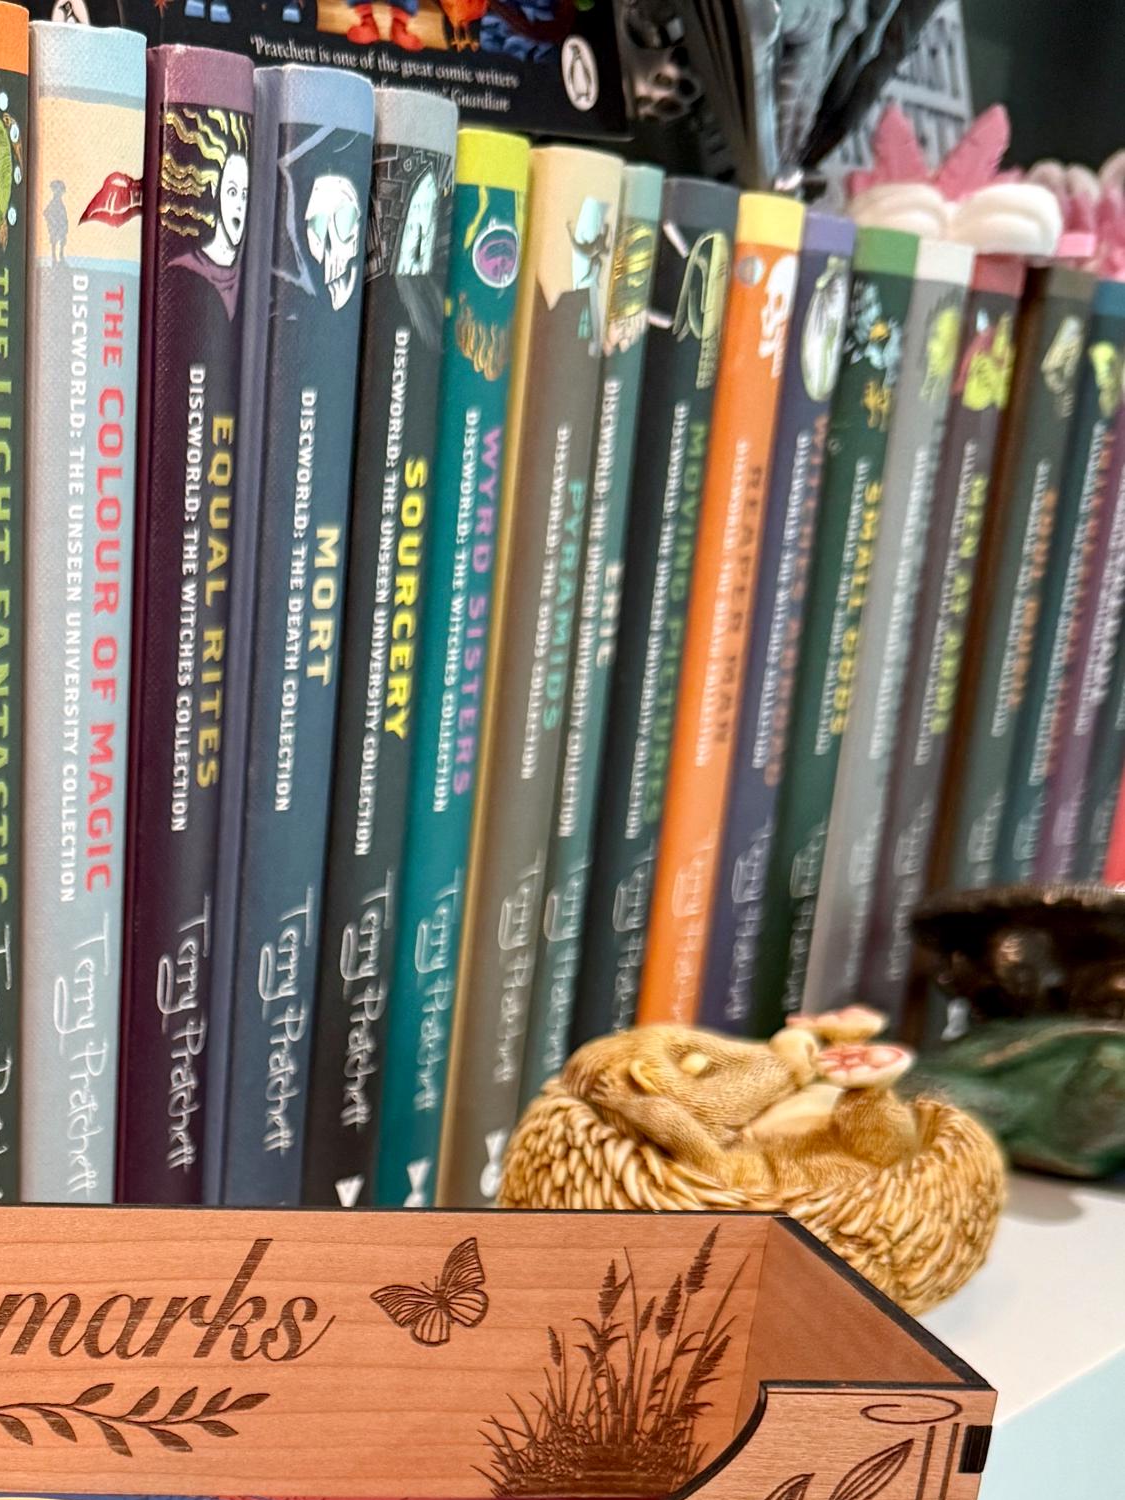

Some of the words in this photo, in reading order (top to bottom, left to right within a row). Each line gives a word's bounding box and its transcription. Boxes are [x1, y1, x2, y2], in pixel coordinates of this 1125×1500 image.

[319, 44, 331, 63] is
[333, 52, 359, 67] one
[360, 50, 374, 69] of
[378, 52, 399, 73] the
[401, 59, 434, 78] great
[435, 65, 475, 83] comic
[475, 68, 520, 88] writers
[451, 87, 510, 112] Guardian
[69, 273, 89, 438] DISCWORLD:
[103, 285, 125, 368] THE
[184, 364, 206, 522] DISCWORLD:
[293, 387, 318, 539] DISCWORLD:
[385, 327, 410, 468] DISCWORLD:
[68, 447, 85, 496] THE
[93, 386, 125, 616] COLOUR
[205, 413, 235, 607] EQUAL
[382, 471, 400, 515] THE
[456, 407, 481, 544] DISCWORLD:
[472, 426, 502, 573] WYRD
[669, 421, 709, 602] MOVING
[66, 505, 84, 602] UNSEEN
[182, 528, 200, 576] THE
[289, 543, 307, 590] THE
[306, 525, 340, 687] MORT
[375, 517, 396, 602] UNSEEN
[385, 454, 428, 740] SOURCERY
[452, 547, 471, 592] THE
[542, 479, 586, 730] PYRAMIDS
[596, 560, 624, 668] ERIC
[62, 612, 82, 755] UNIVERSITY
[90, 634, 118, 704] OF
[176, 580, 198, 687] WITCHES
[284, 594, 305, 670] DEATH
[365, 608, 390, 731] UNIVERSITY
[444, 595, 465, 686] WITCHES
[453, 596, 485, 795] SISTERS
[171, 690, 193, 832] COLLECTION
[196, 628, 225, 788] RITES
[275, 677, 299, 811] COLLECTION
[433, 690, 457, 812] COLLECTION
[60, 764, 79, 902] COLLECTION
[86, 721, 116, 893] MAGIC
[354, 733, 379, 856] COLLECTION
[53, 912, 110, 1055] Terry
[157, 893, 211, 1033] Terry
[259, 883, 314, 1021] Terry
[340, 867, 395, 999] Terry
[68, 1039, 109, 1198] Pratchett
